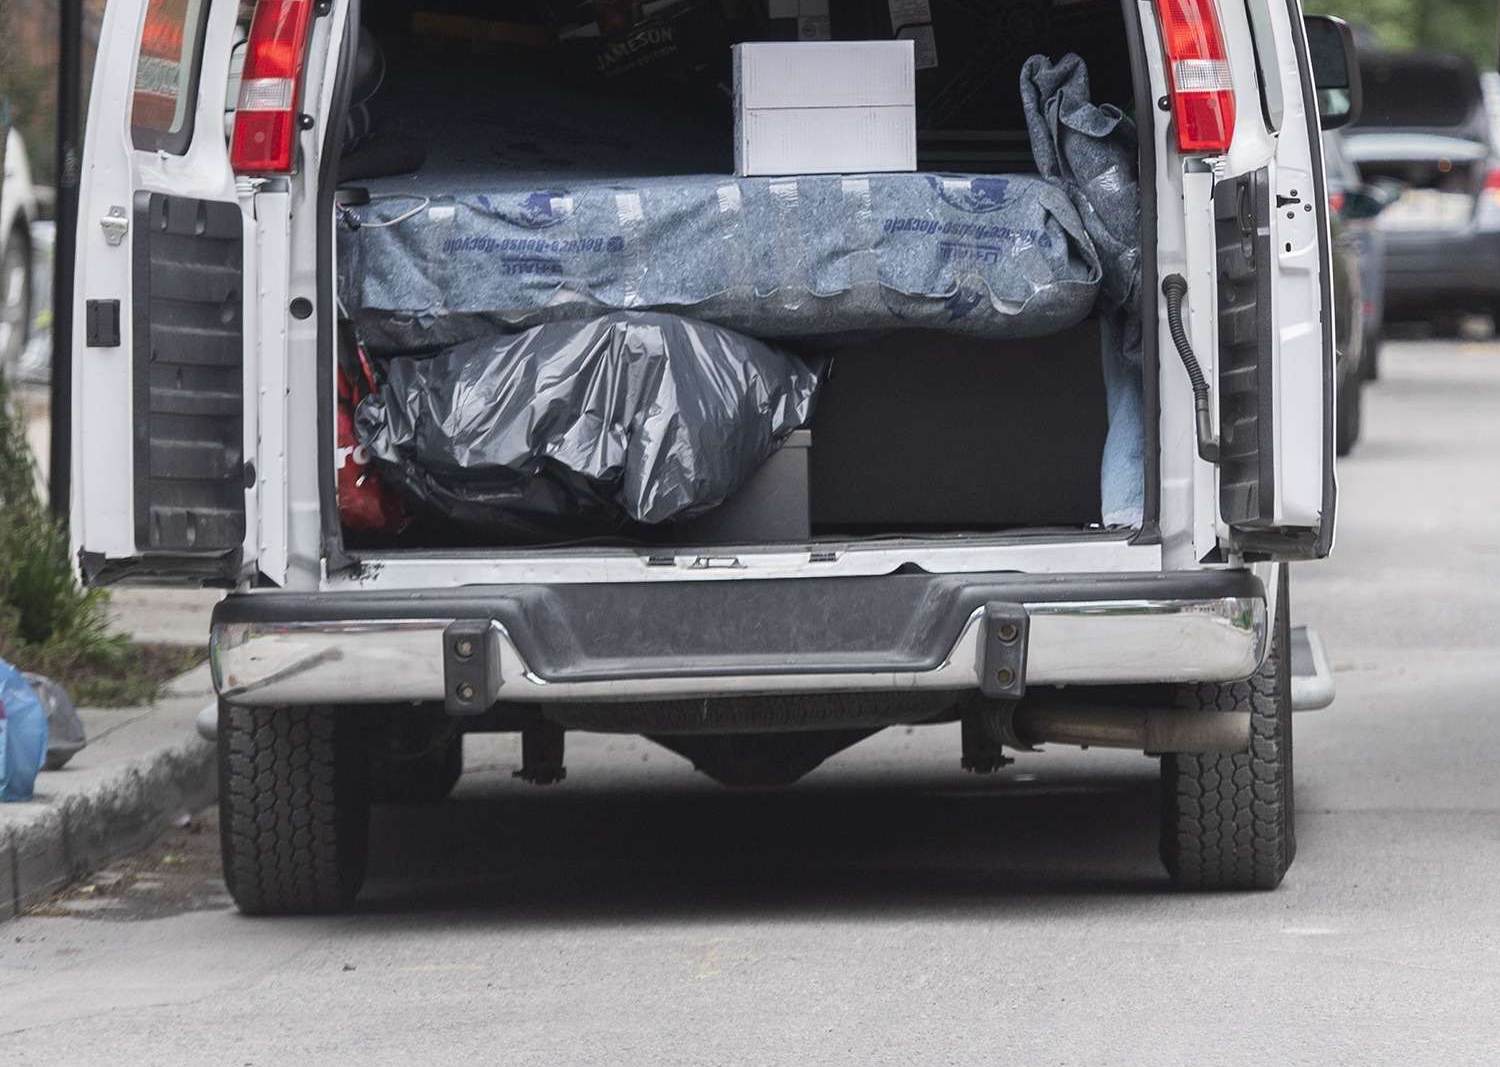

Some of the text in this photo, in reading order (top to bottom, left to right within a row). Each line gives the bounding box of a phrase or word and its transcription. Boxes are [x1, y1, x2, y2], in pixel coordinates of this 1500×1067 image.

[597, 26, 674, 71] JAMESON
[883, 217, 939, 235] Recycle
[442, 235, 497, 254] Recycle
